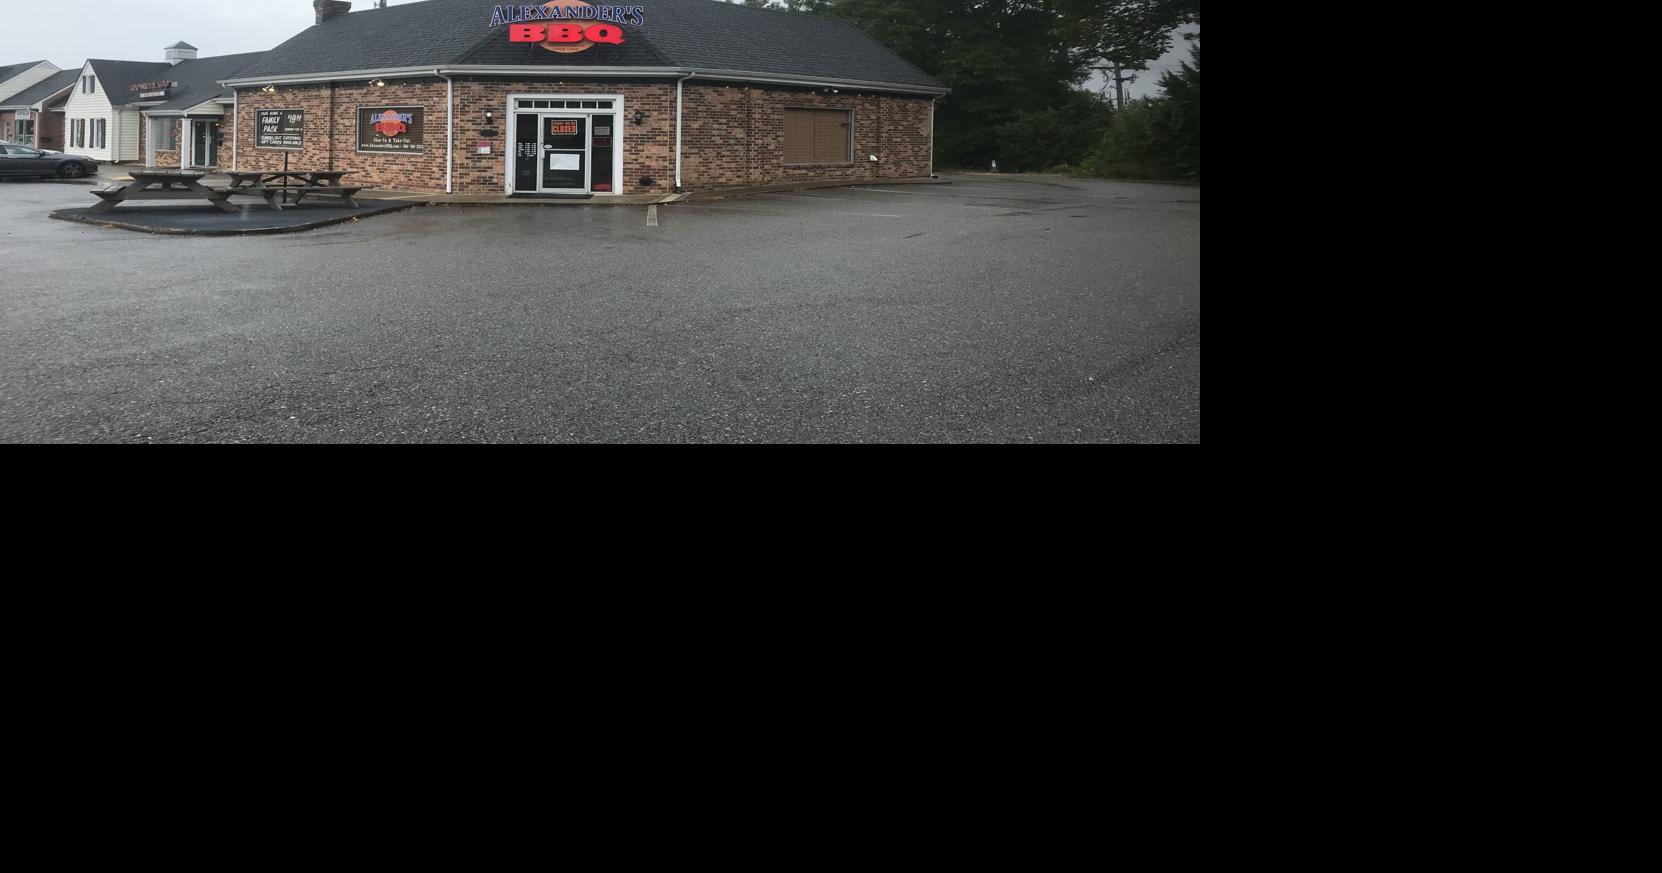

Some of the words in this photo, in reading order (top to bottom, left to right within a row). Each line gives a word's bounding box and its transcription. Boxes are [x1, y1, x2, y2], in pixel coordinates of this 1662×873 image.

[489, 5, 644, 28] ALEXANDER'S
[509, 23, 625, 45] BBQ
[262, 116, 280, 124] FAMILY
[552, 125, 576, 133] CLOSED
